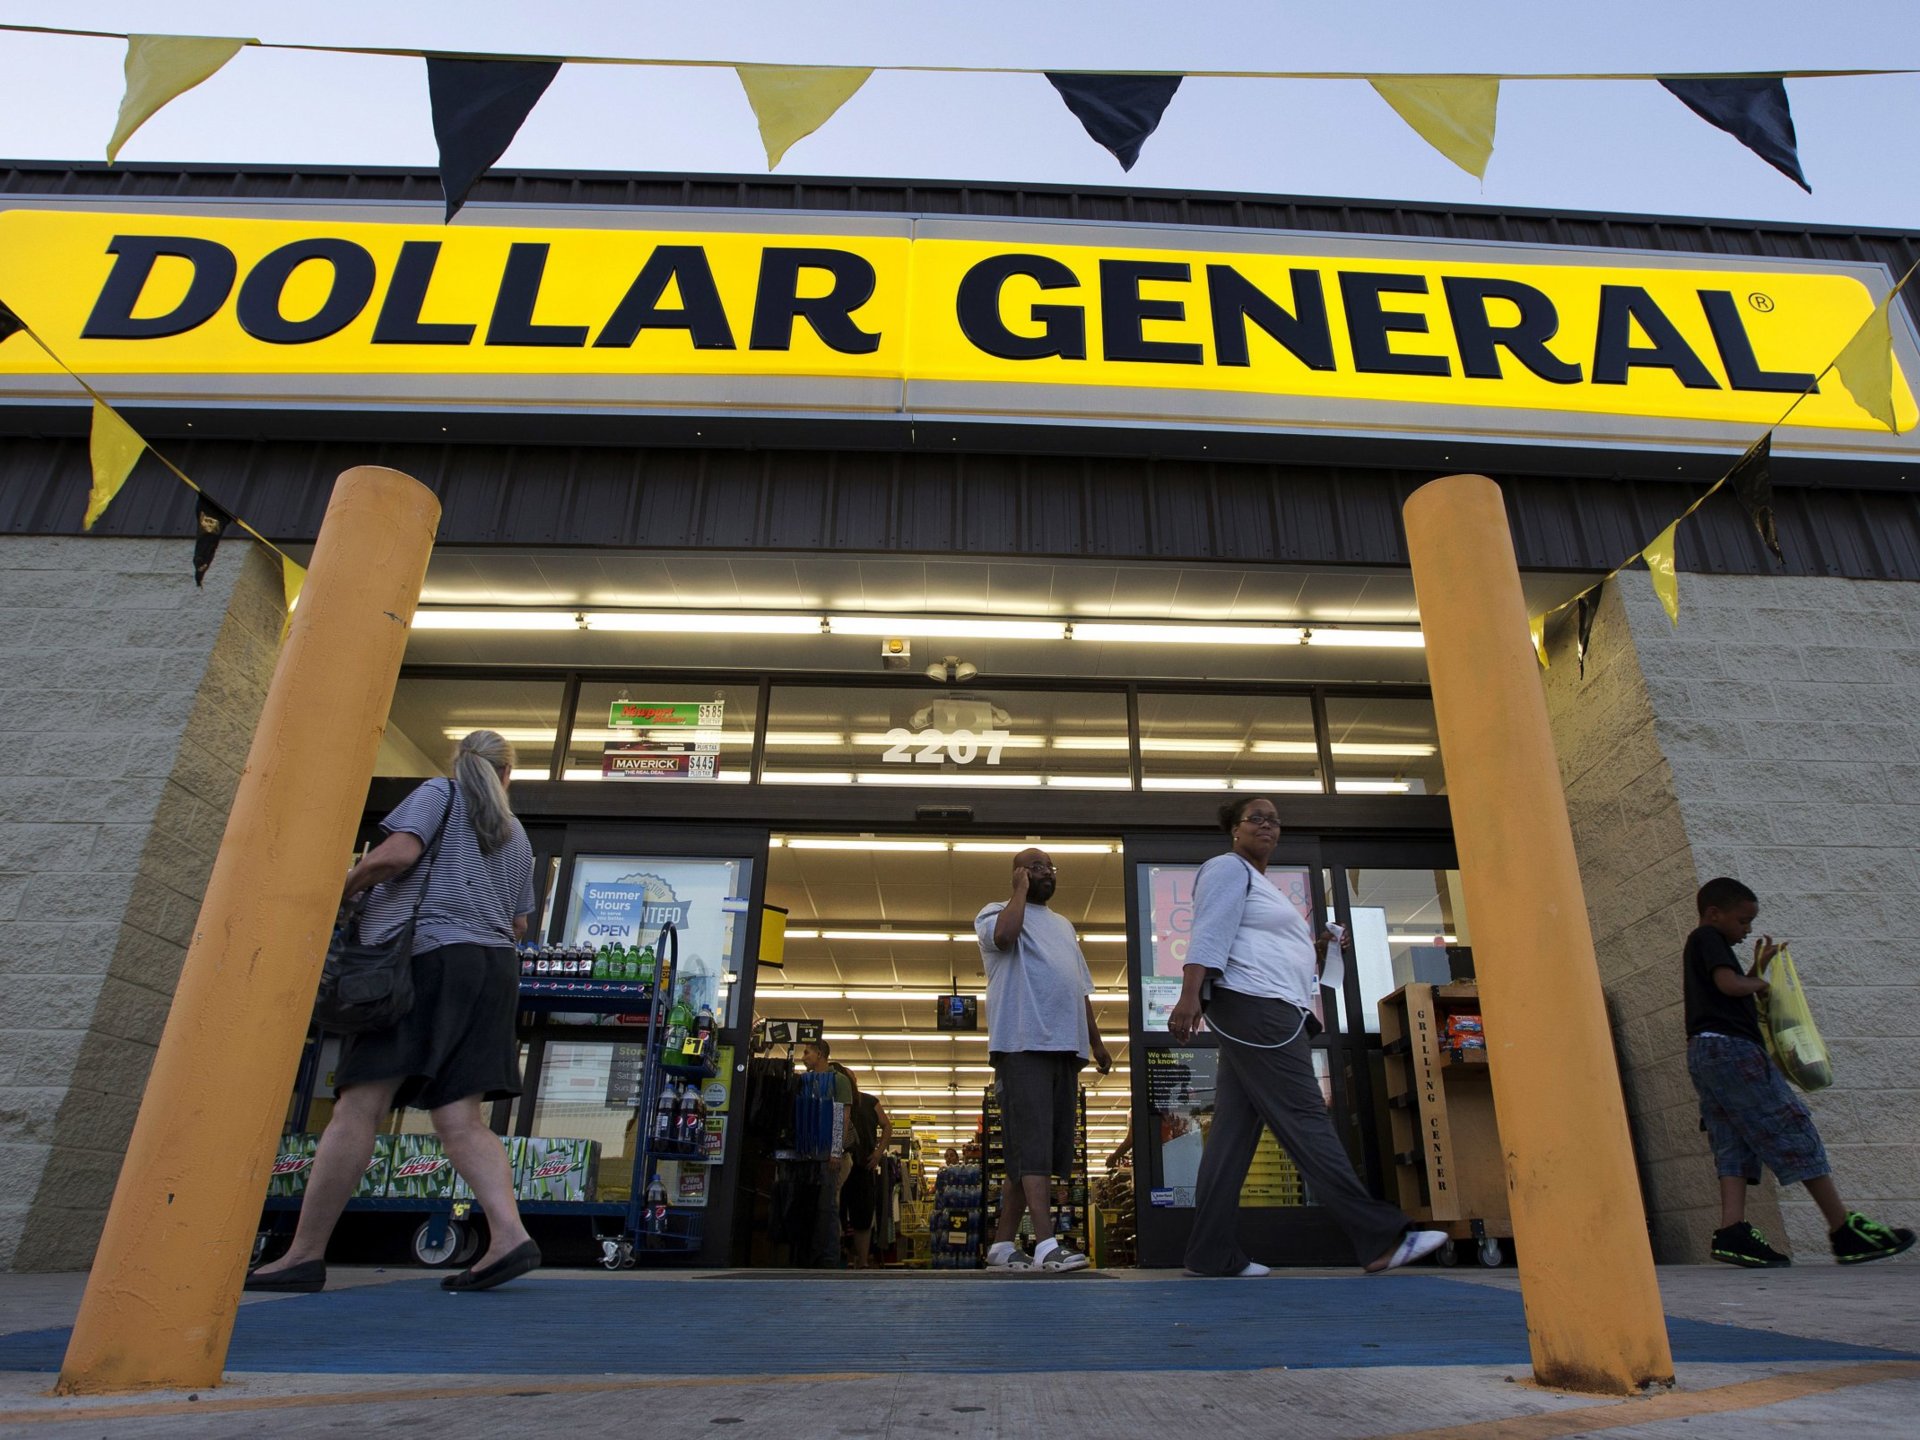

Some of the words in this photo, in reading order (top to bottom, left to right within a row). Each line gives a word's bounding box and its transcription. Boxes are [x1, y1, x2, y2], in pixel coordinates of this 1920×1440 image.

[79, 234, 882, 355] DOLLAR
[955, 252, 1822, 395] GENERAL
[882, 728, 1010, 765] 2207
[616, 759, 675, 770] MAVERICK
[588, 889, 641, 901] Summer
[595, 901, 631, 911] Hours
[588, 924, 630, 937] OPEN
[1417, 1010, 1435, 1103] GRILLING
[1430, 1118, 1447, 1191] CENTER
